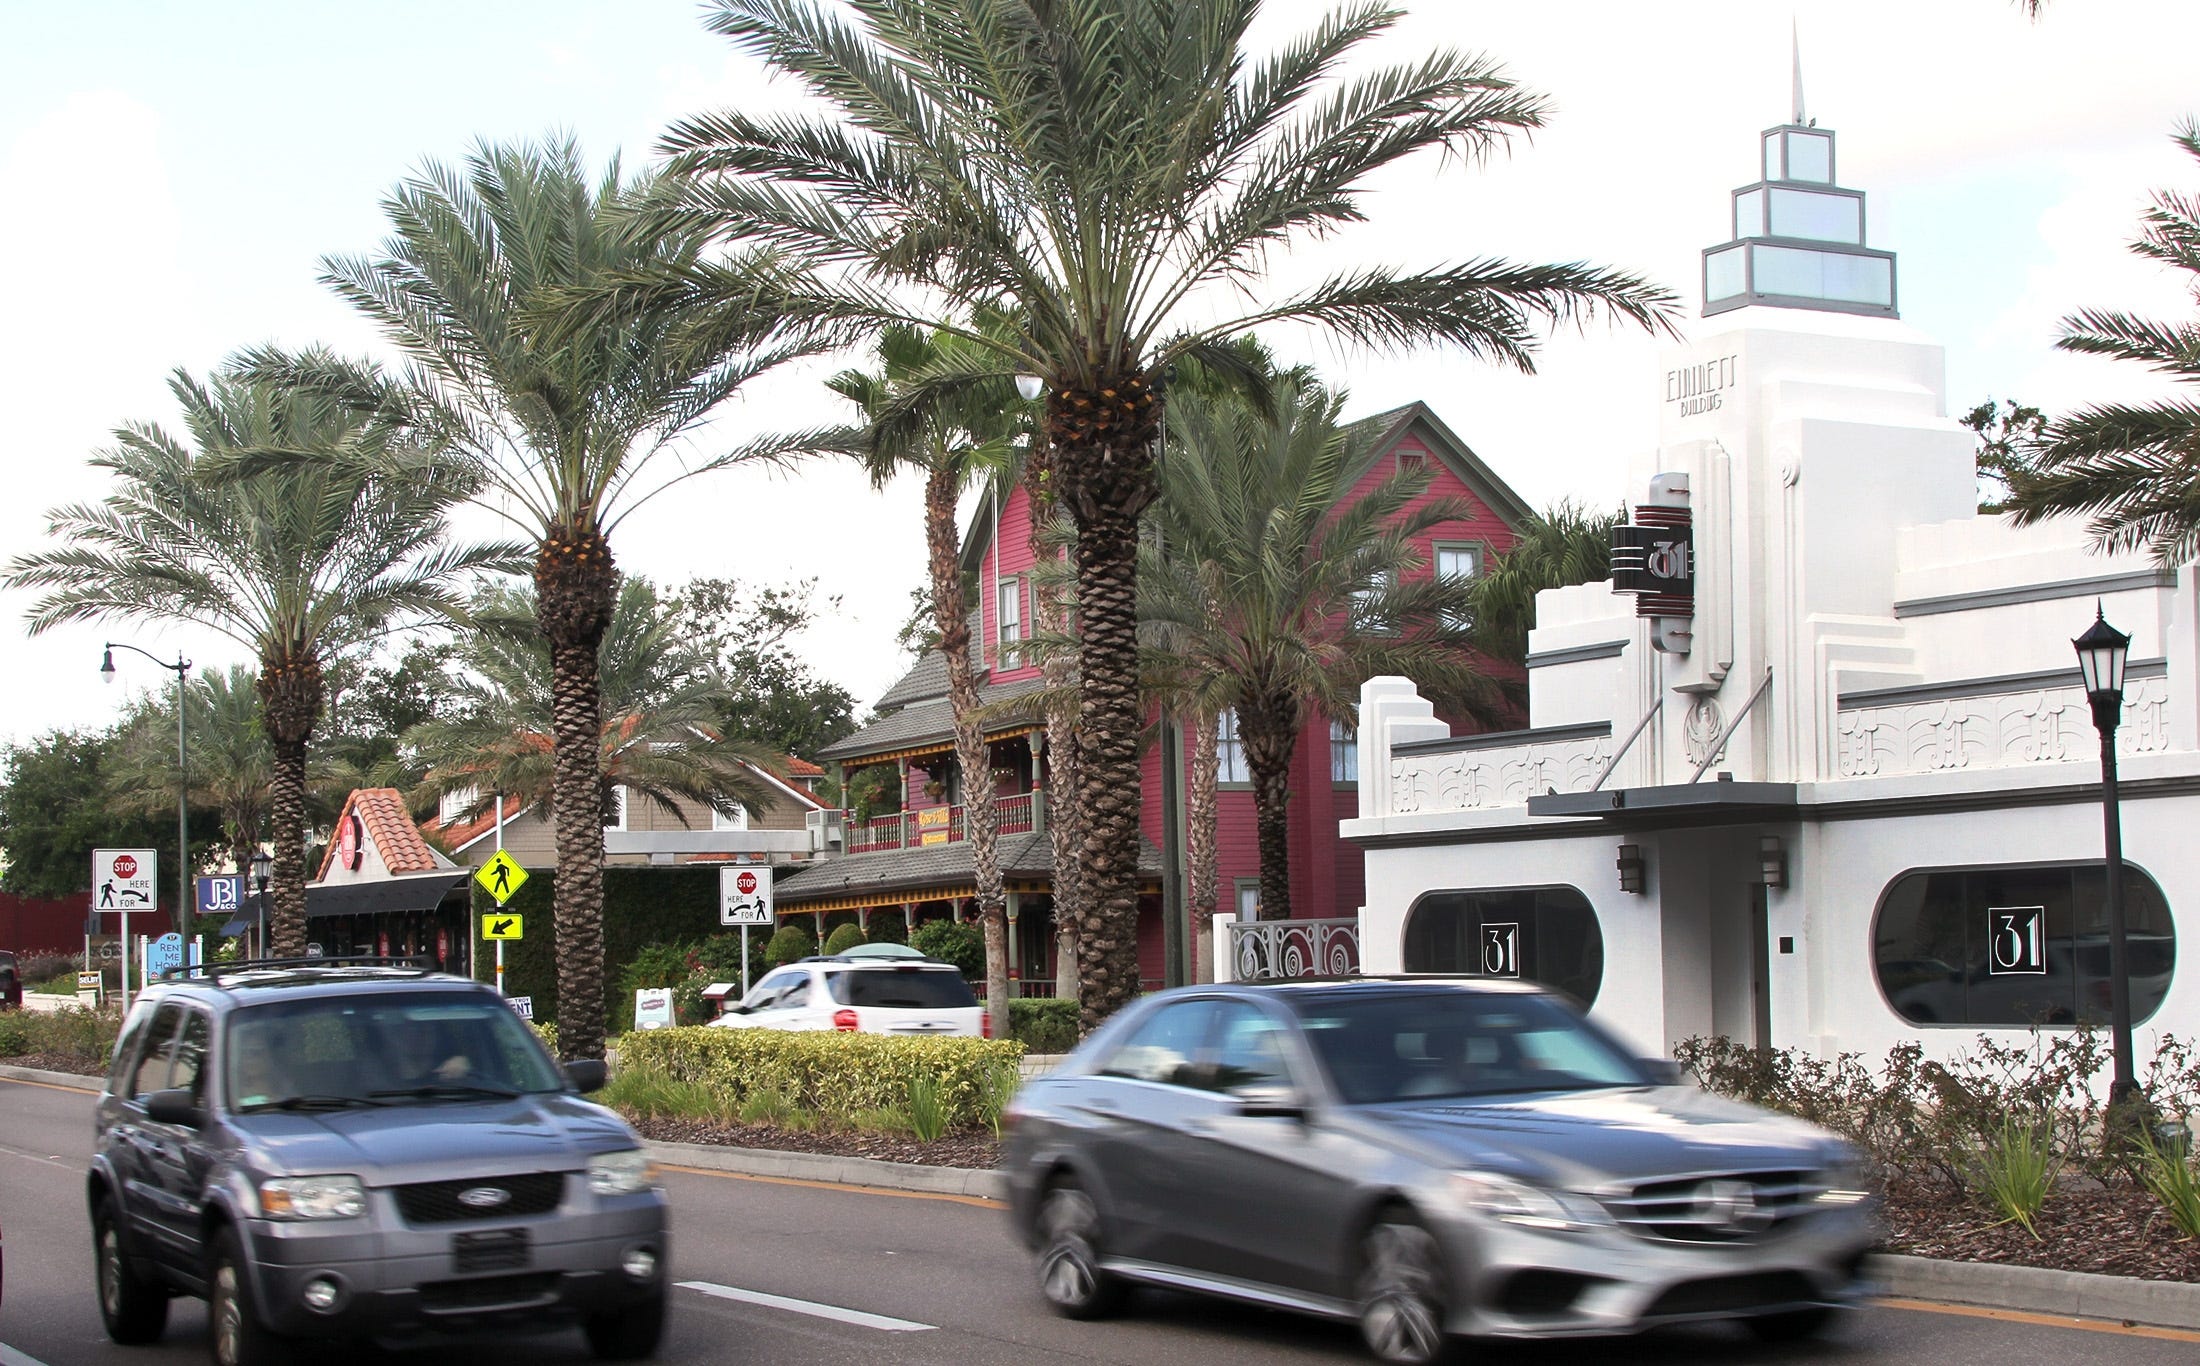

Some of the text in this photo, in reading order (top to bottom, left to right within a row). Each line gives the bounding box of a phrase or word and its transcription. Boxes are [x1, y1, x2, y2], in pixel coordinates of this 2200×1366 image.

[1680, 393, 1722, 418] BUILDING
[1648, 540, 1688, 579] 31
[114, 862, 136, 872] STOP
[129, 880, 150, 888] HERE
[738, 878, 756, 888] STOP
[120, 899, 135, 908] FOR
[727, 895, 744, 903] HERE
[741, 911, 754, 919] FOR
[1995, 913, 2040, 968] 31
[160, 943, 184, 951] REN
[1485, 929, 1516, 973] 31
[165, 953, 180, 961] ME
